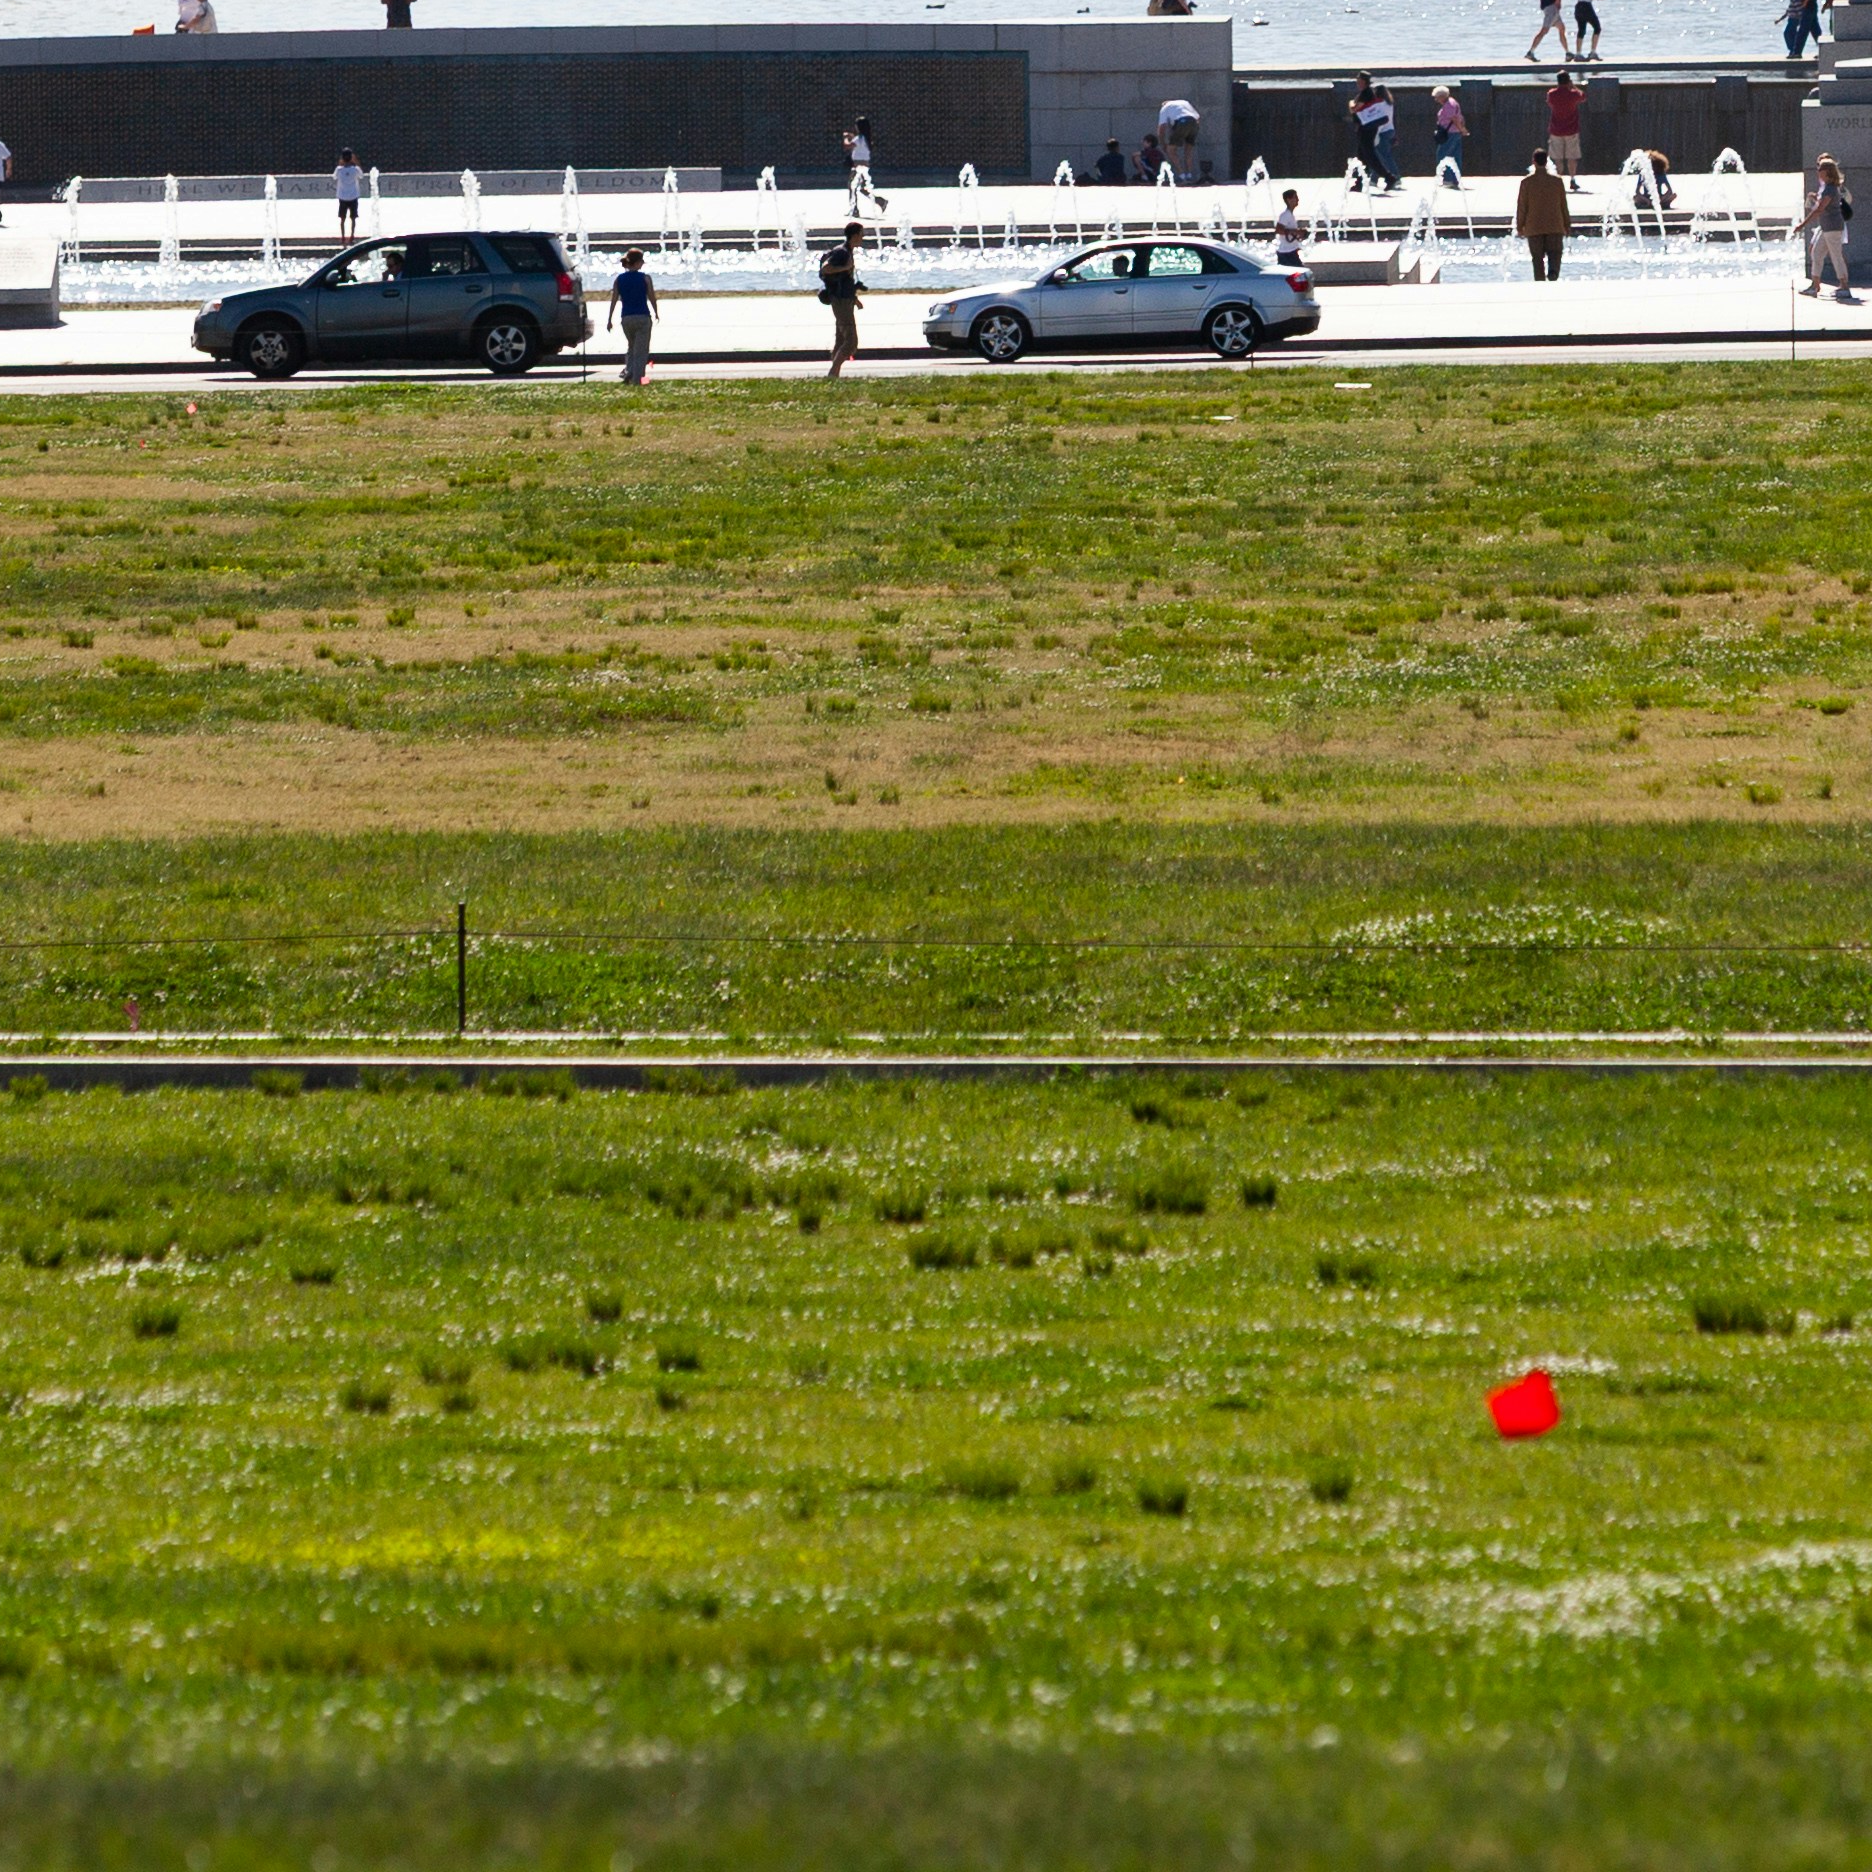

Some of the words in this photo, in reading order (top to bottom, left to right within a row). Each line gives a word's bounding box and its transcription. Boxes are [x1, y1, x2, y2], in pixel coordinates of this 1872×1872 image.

[218, 183, 253, 195] WE
[277, 182, 337, 193] ARK
[501, 178, 532, 188] OF
[547, 175, 665, 189] FEEDOM
